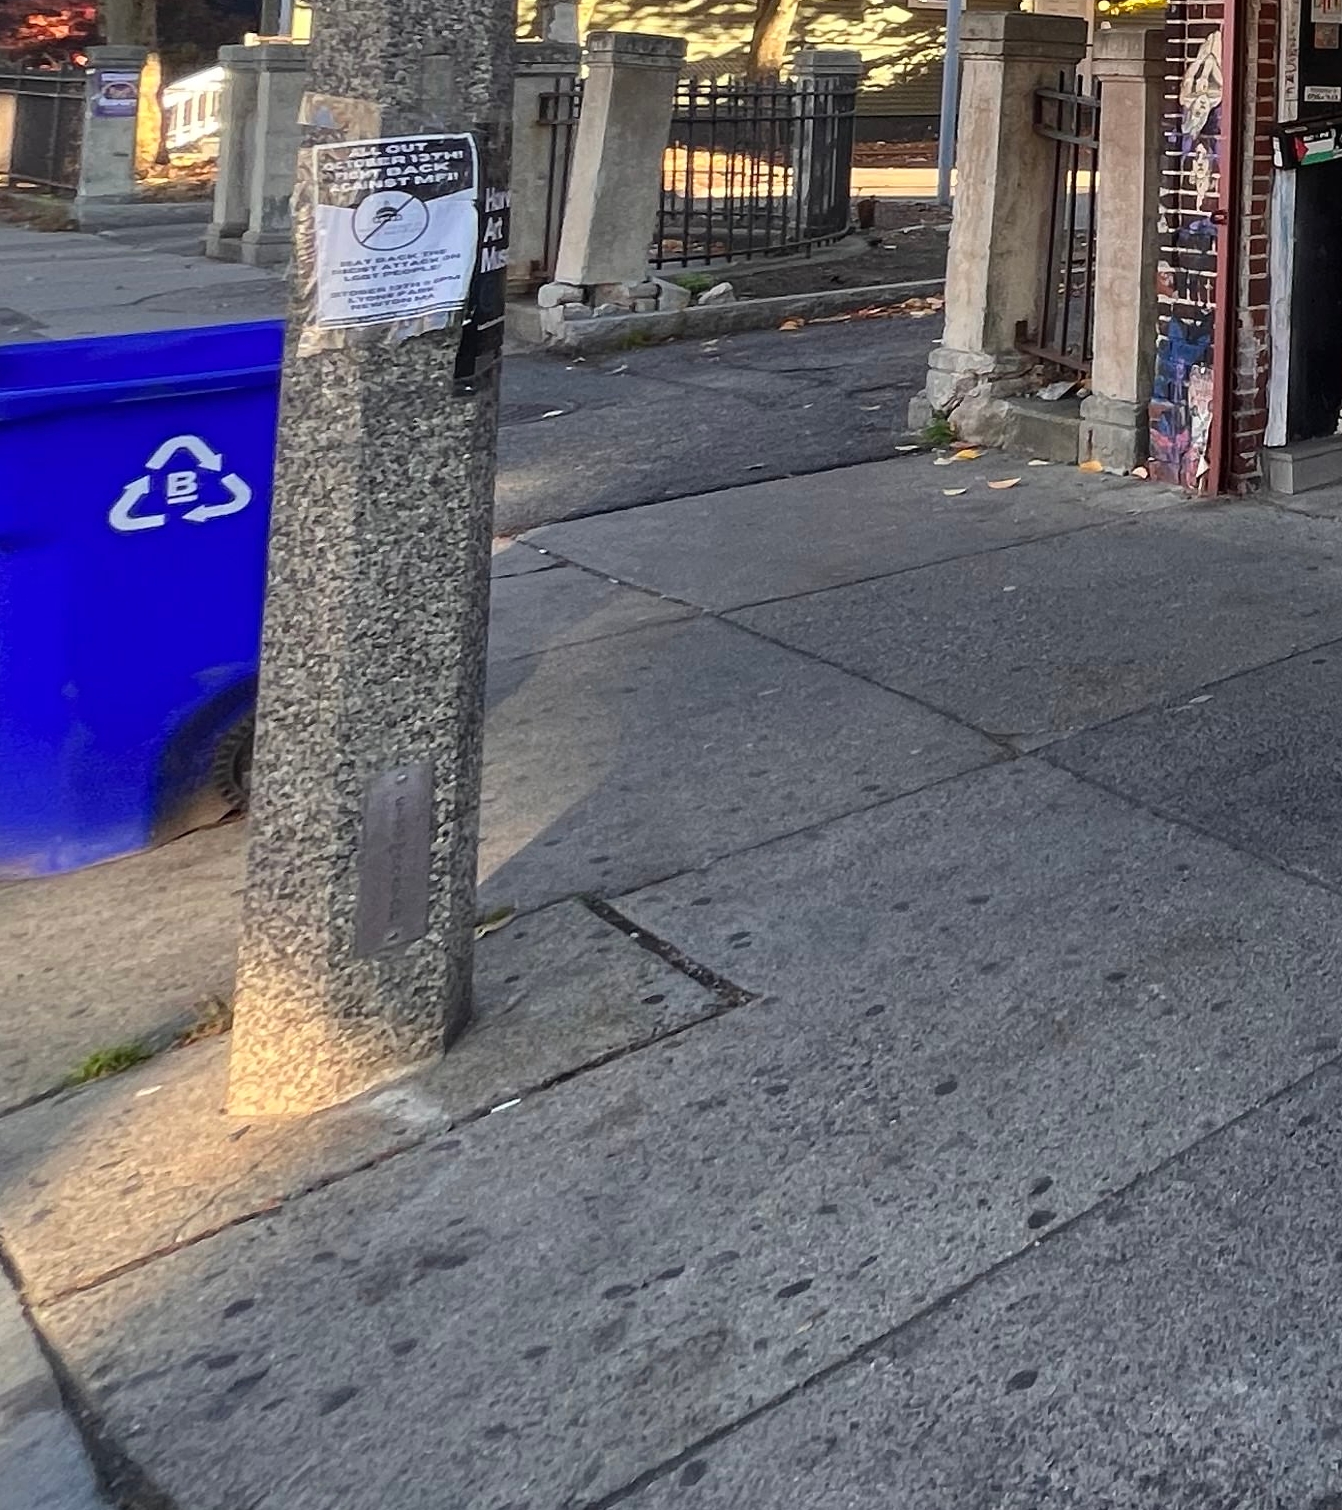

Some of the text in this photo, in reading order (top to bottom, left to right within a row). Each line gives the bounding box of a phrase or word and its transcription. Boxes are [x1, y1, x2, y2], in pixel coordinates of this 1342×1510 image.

[349, 142, 428, 158] ALL OUT
[322, 155, 406, 172] OCTOBER
[386, 162, 450, 176] BACK
[329, 177, 410, 192] AGAINST
[165, 471, 197, 499] B
